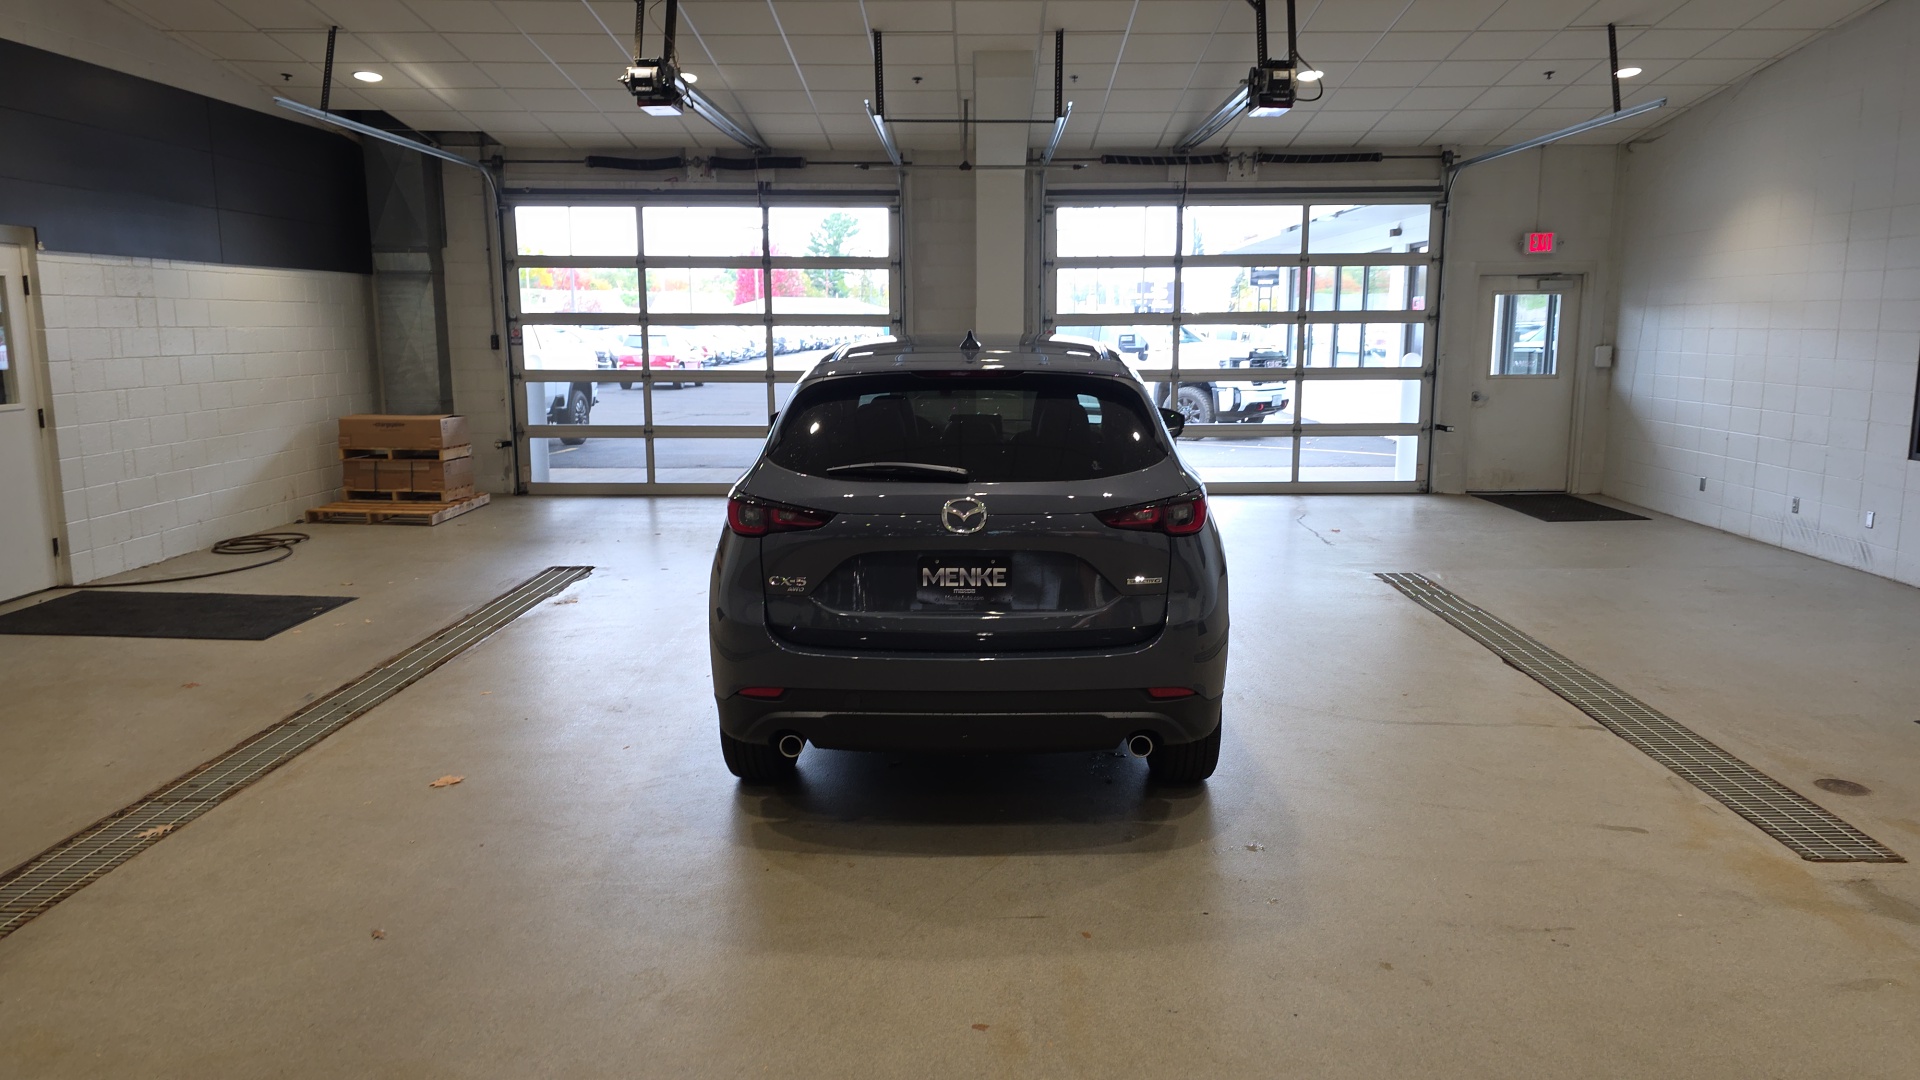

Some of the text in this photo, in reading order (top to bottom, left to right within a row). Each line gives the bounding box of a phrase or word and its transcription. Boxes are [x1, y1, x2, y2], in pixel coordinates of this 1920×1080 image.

[1529, 232, 1554, 252] EXIT
[768, 575, 807, 587] CX-5
[922, 567, 1007, 587] MENKE
